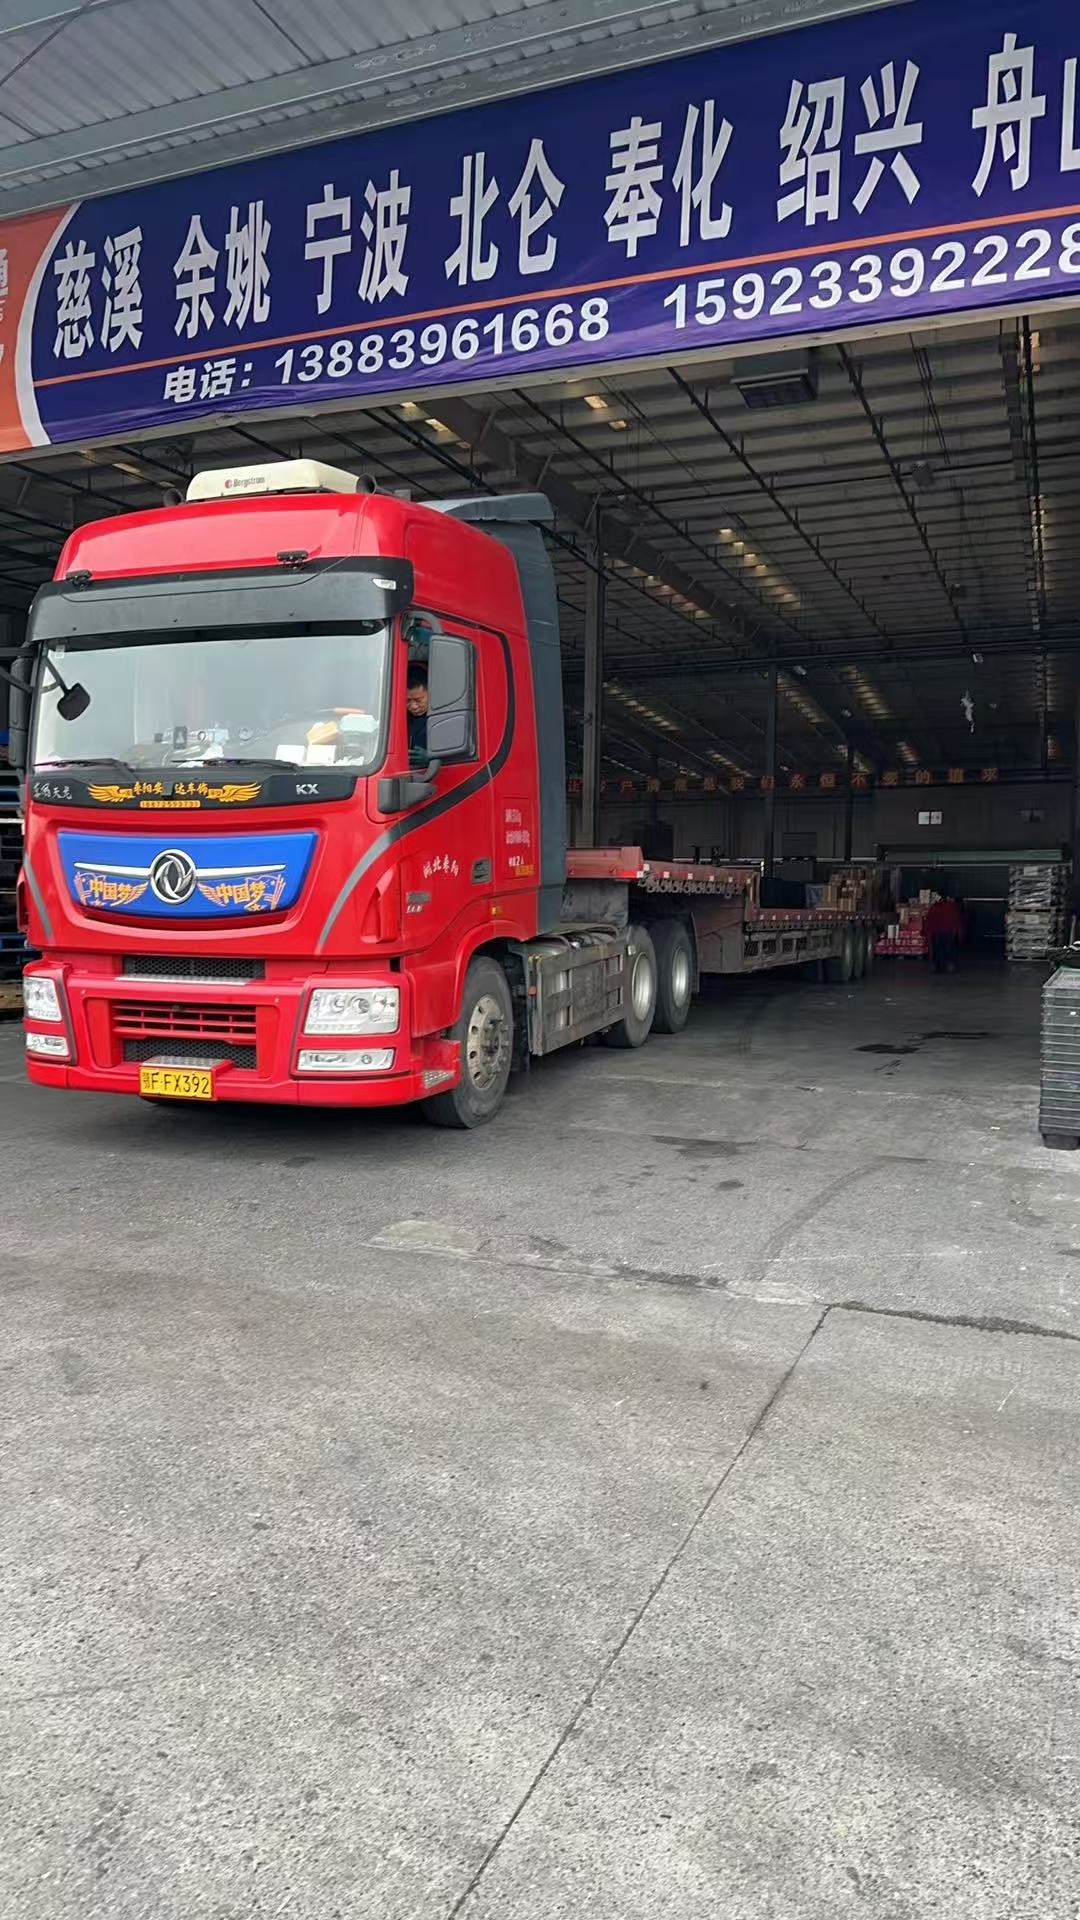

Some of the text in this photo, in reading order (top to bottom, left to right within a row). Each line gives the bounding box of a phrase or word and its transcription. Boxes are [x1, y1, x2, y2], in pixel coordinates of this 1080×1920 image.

[53, 226, 144, 360] 慈溪
[173, 200, 272, 339] 余姚
[305, 169, 412, 314] 宁波
[444, 138, 565, 286] 北仑
[603, 99, 734, 259] 奉化
[776, 59, 924, 227] 绍兴
[663, 221, 1080, 330] 15923392228
[295, 783, 320, 795] KX
[89, 877, 137, 905] 中国梦
[215, 880, 267, 907] 中国梦
